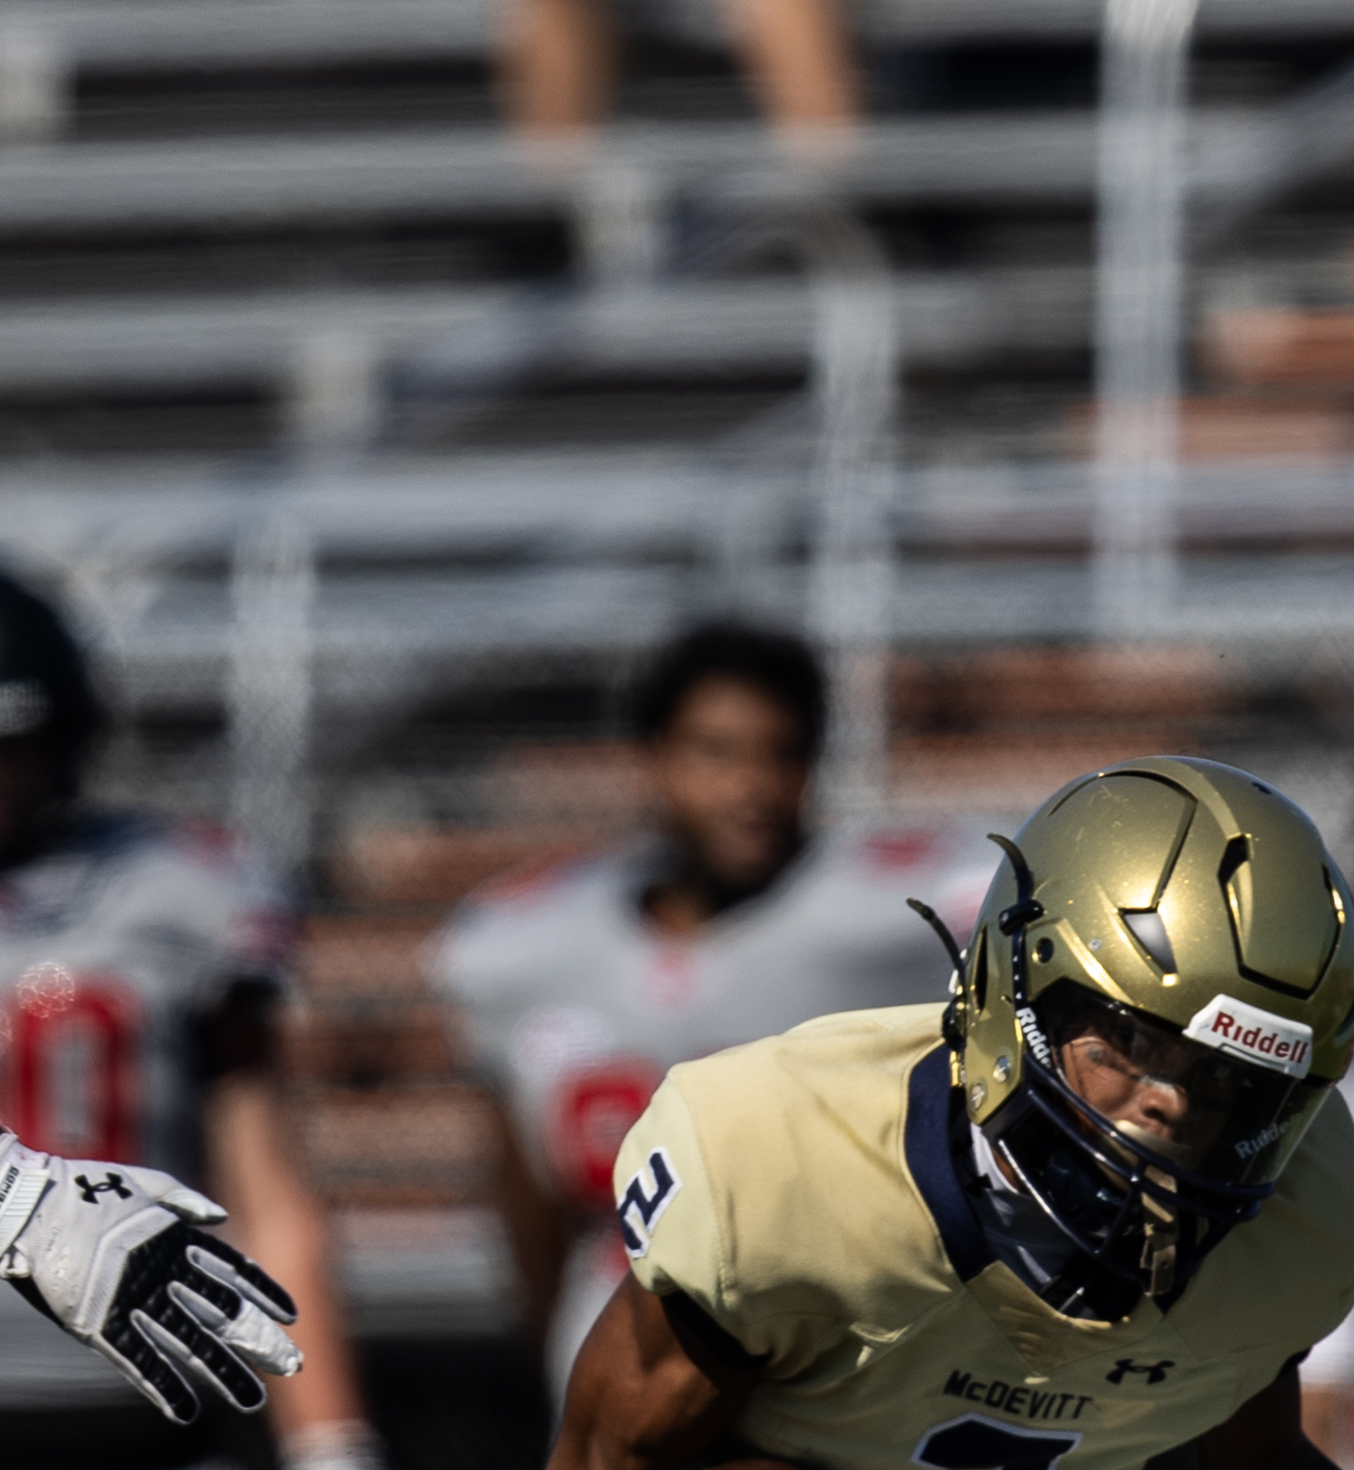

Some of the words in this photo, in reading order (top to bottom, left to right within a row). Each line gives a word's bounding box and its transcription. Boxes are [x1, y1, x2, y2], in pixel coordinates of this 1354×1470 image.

[1211, 1011, 1308, 1064] Riddell
[616, 1146, 684, 1259] 2
[943, 1369, 1093, 1421] McDEVITT
